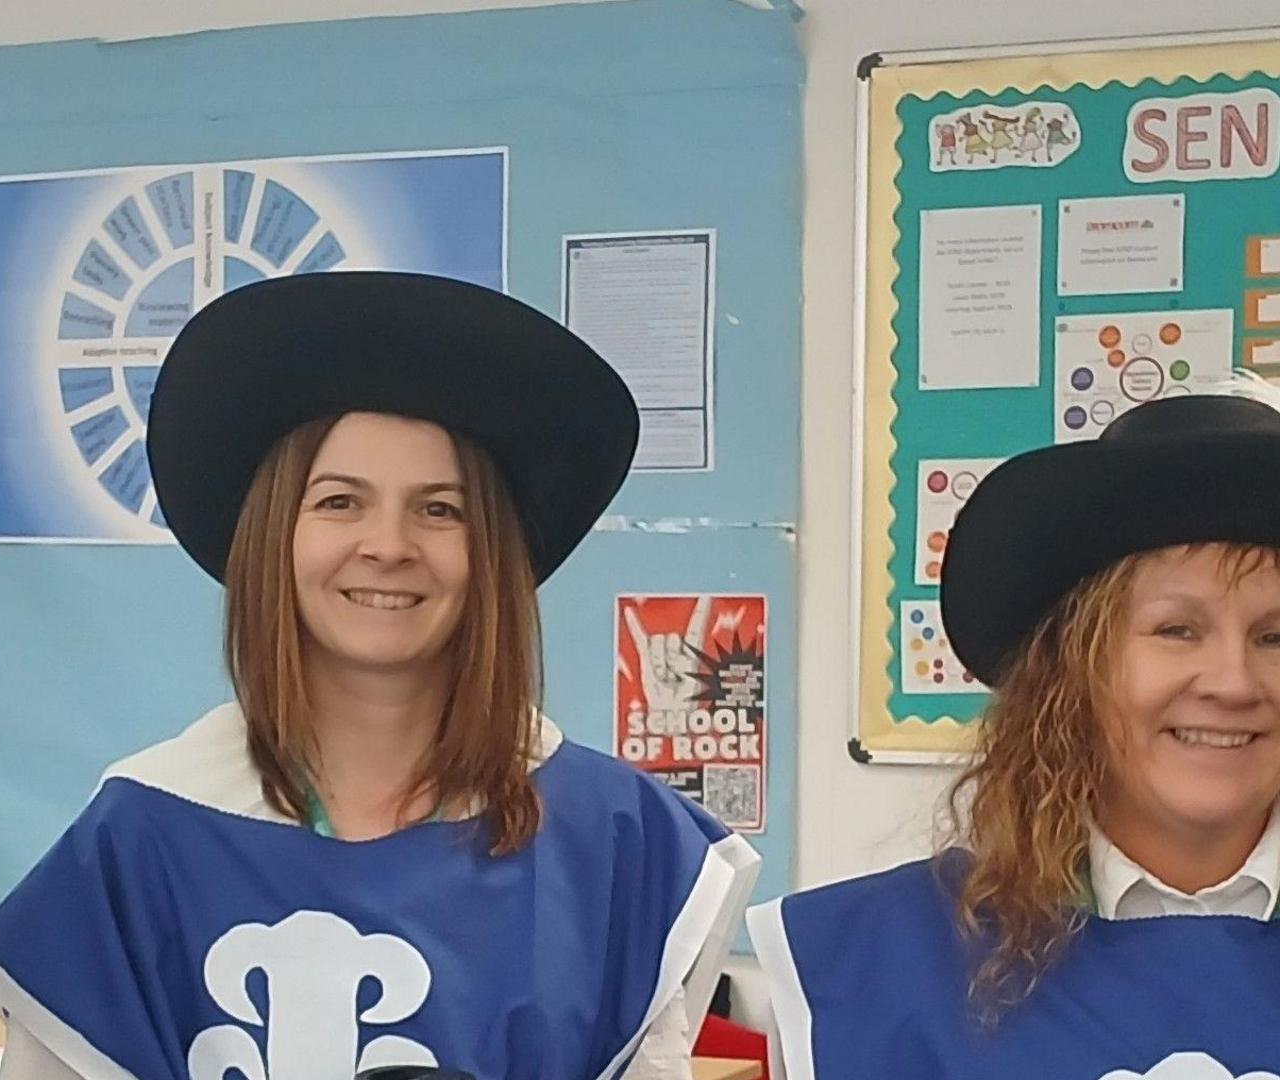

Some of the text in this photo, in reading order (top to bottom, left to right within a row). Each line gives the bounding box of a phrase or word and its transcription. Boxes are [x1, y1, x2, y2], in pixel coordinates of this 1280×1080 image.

[1131, 102, 1268, 173] SEN
[628, 708, 756, 736] SCHOOL
[622, 734, 760, 762] OF ROCK
